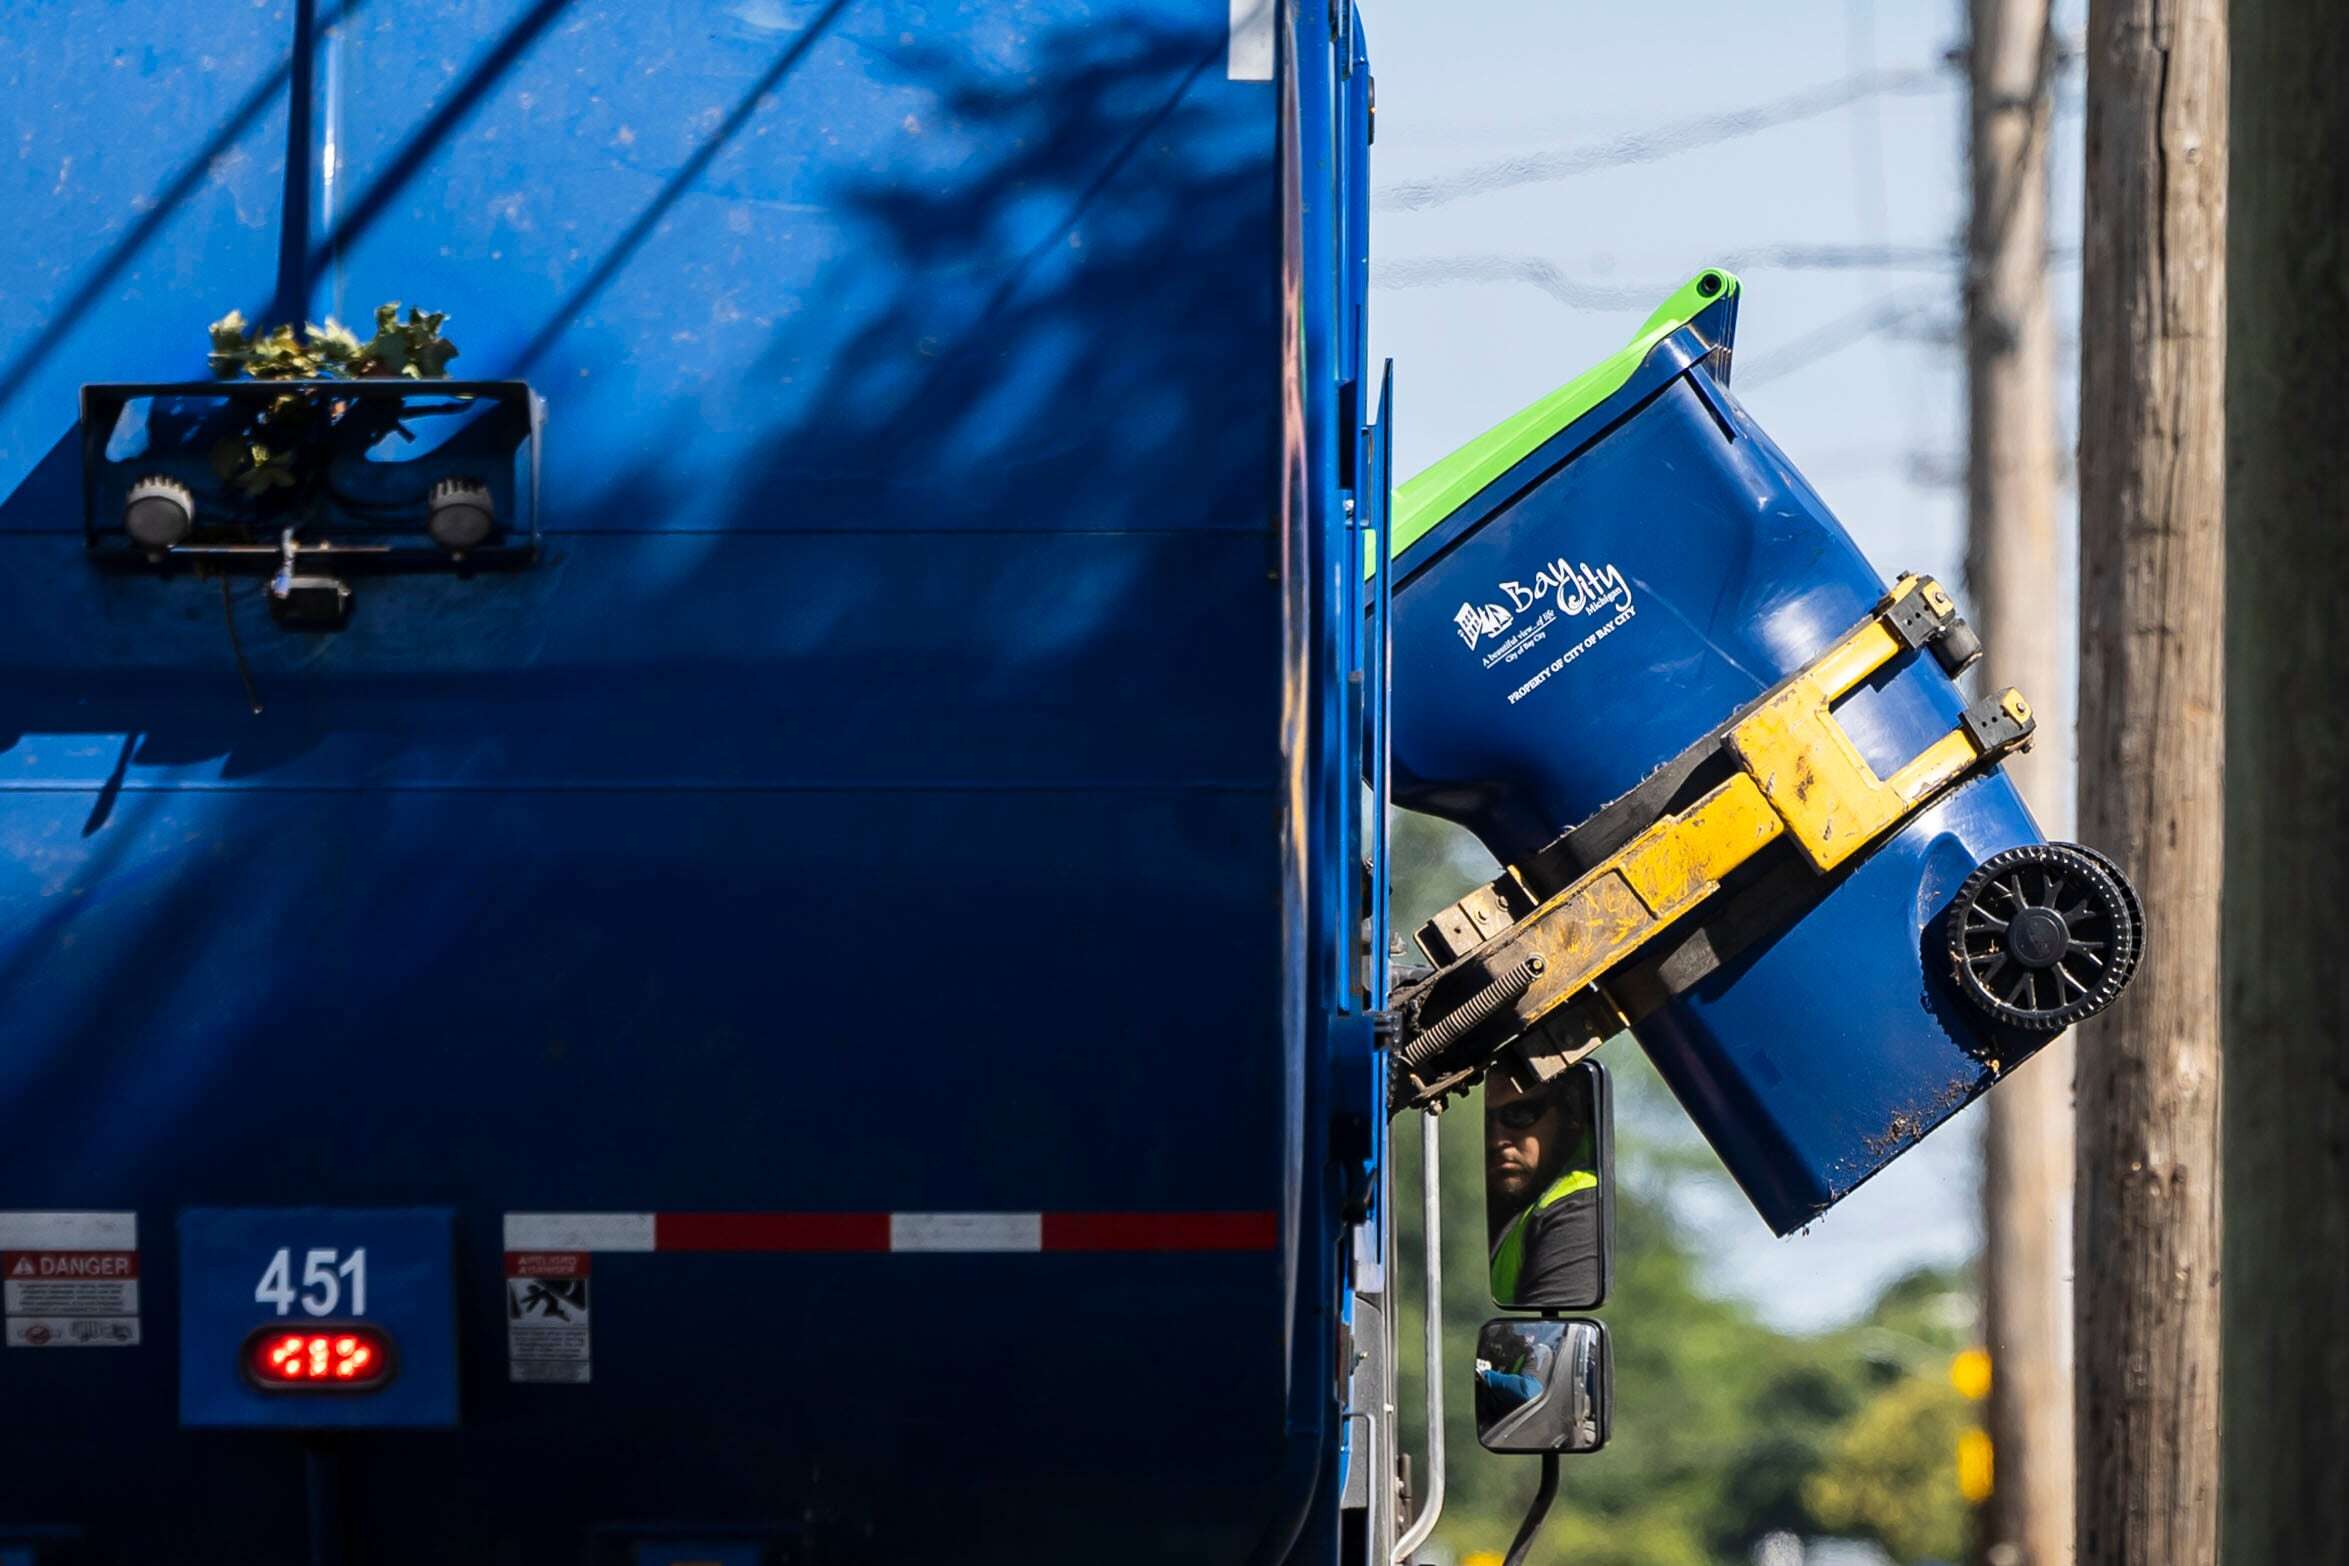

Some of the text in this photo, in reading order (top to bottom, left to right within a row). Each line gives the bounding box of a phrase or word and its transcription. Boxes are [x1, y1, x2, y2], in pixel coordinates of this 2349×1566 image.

[1499, 558, 1586, 614] Bay
[1507, 606, 1636, 704] PROPERTY OF CITY OF BAY CITY
[40, 1257, 129, 1275] DANGER
[255, 1248, 366, 1316] 451
